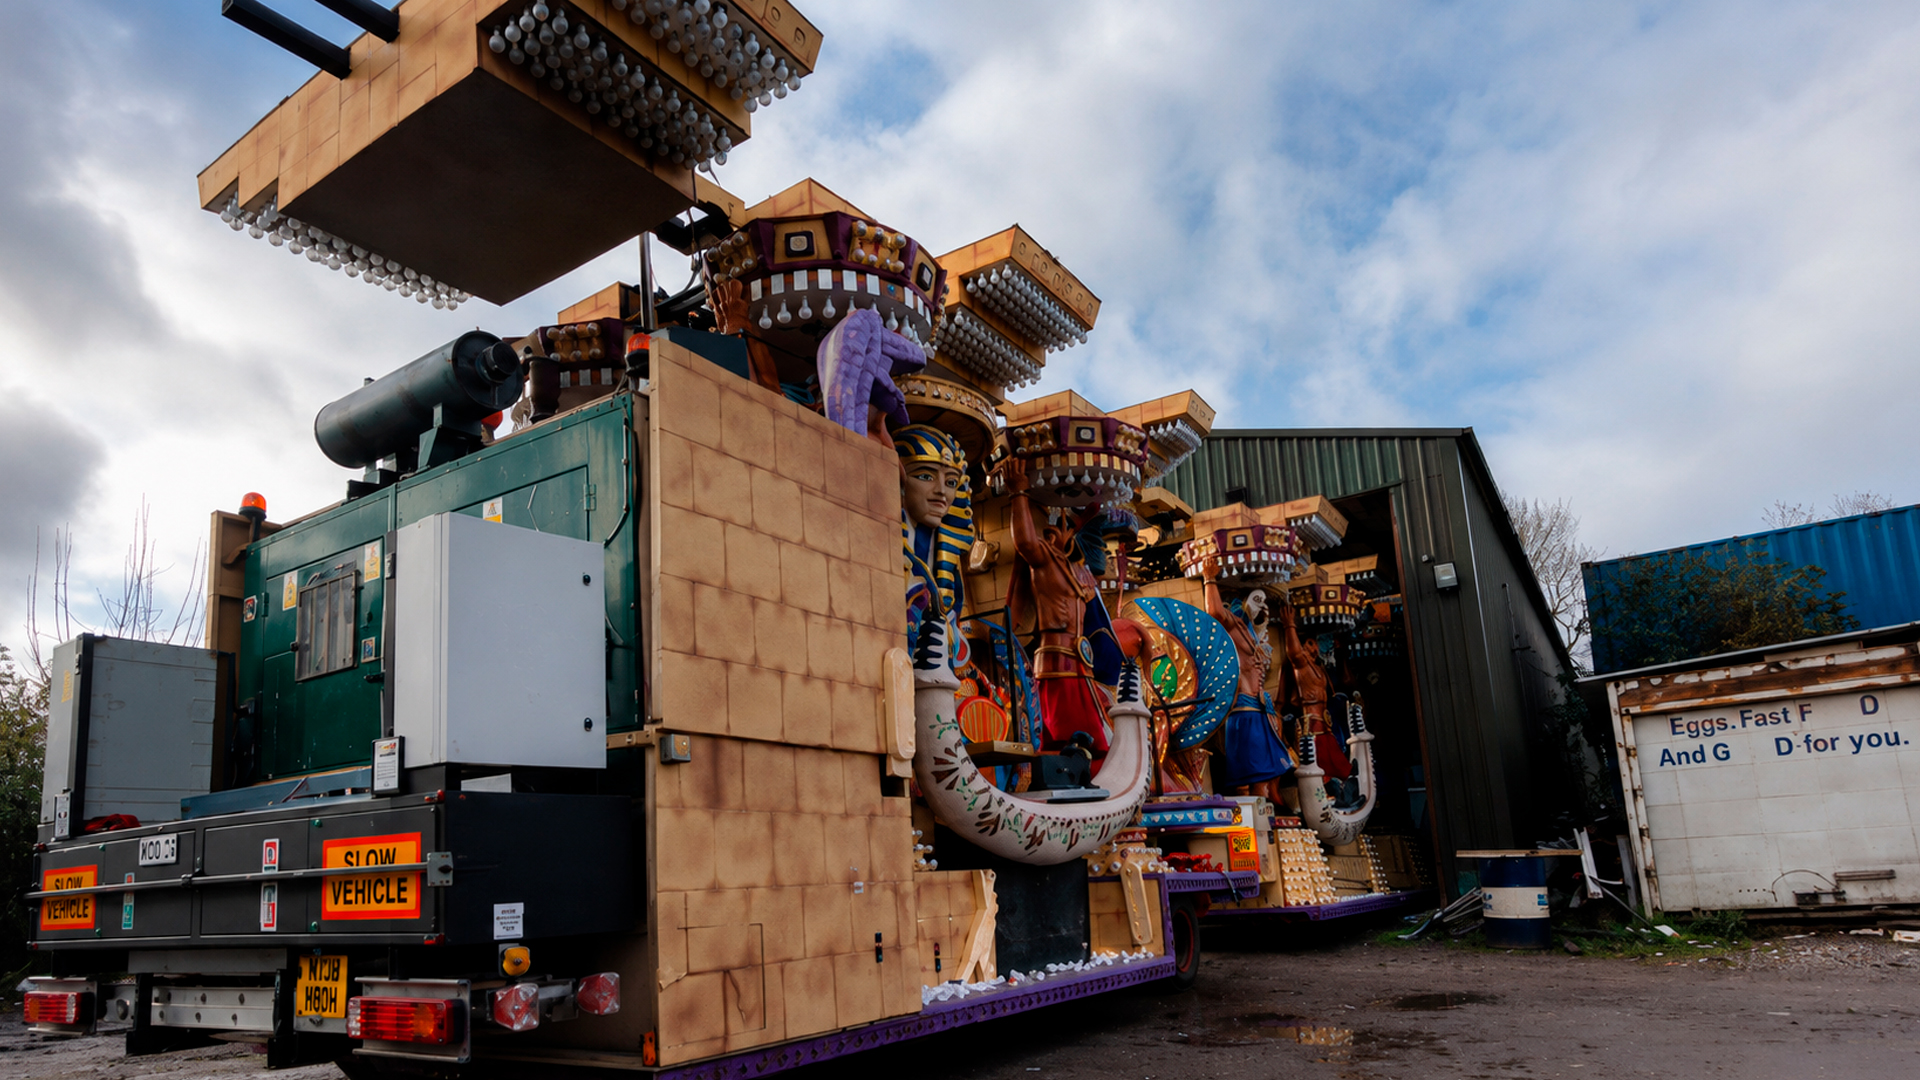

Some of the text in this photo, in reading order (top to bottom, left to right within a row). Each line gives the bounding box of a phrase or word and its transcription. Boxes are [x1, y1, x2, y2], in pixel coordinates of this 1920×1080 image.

[1740, 707, 1792, 728] Fast
[1659, 744, 1706, 767] And
[1712, 742, 1731, 761] G
[1848, 731, 1909, 754] you.
[332, 877, 408, 905] VEHICLE
[46, 898, 90, 920] VEHICLE
